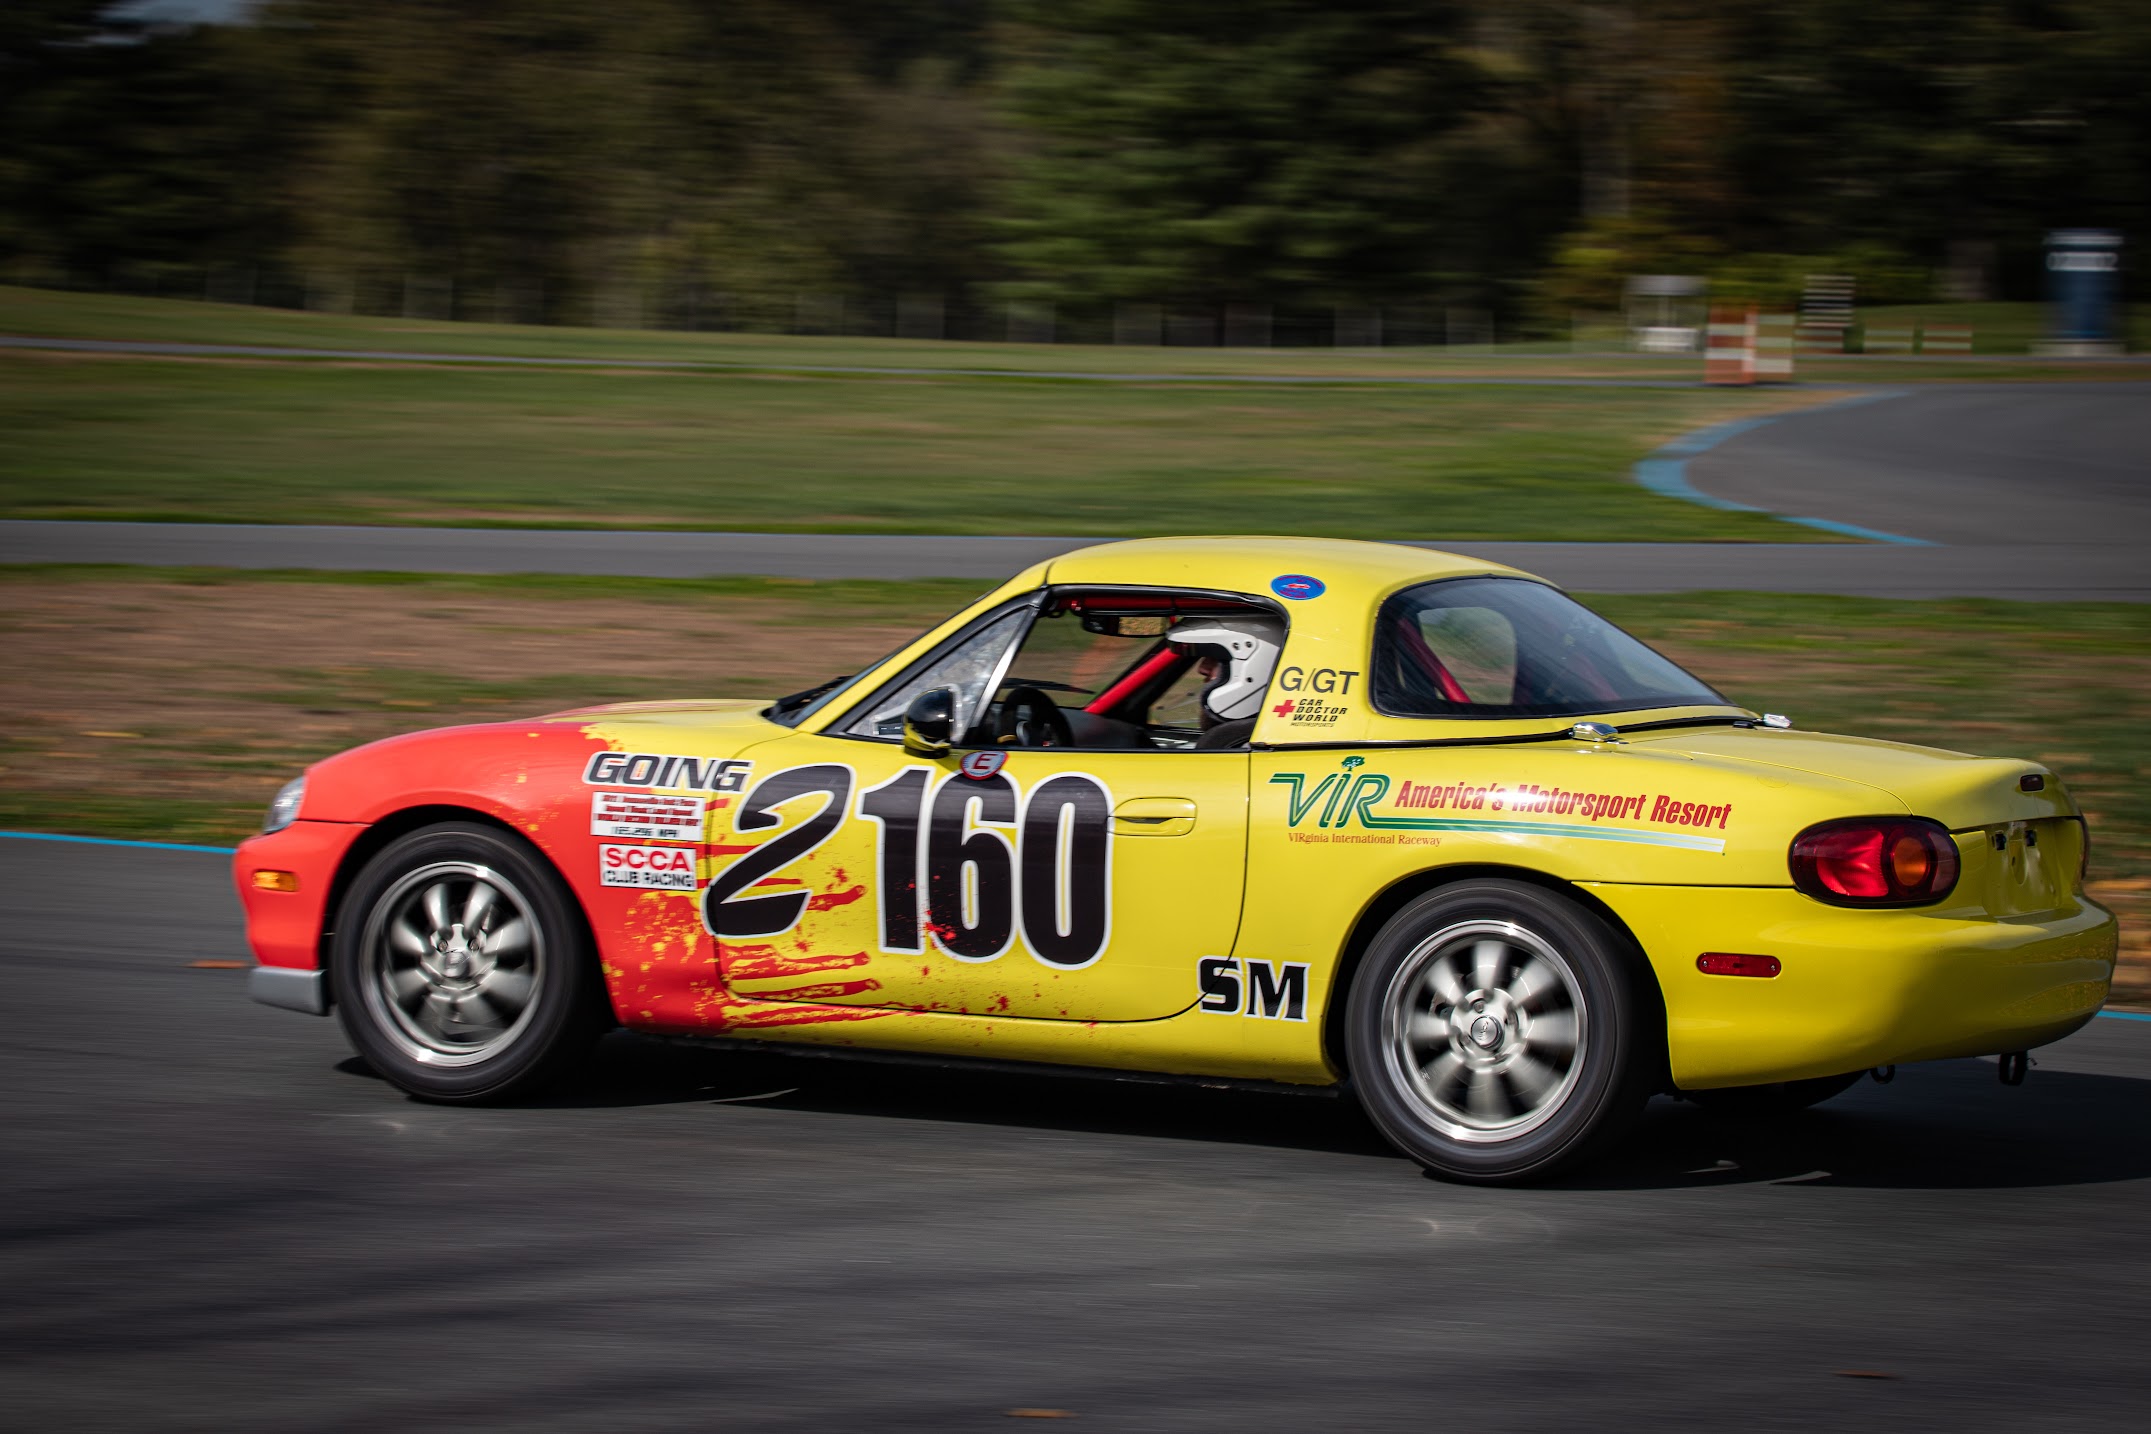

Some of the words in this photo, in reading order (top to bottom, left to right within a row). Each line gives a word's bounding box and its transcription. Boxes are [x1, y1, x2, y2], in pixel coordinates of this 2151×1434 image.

[1280, 666, 1359, 694] G/GT
[1296, 706, 1347, 714] DOCTOR
[1299, 698, 1323, 706] CAR
[1293, 714, 1338, 722] WORLD
[972, 753, 998, 769] E
[586, 751, 752, 792] GOING
[1394, 780, 1508, 811] America's
[1512, 784, 1647, 822] Motorsport
[1650, 794, 1732, 830] Resort
[1331, 832, 1395, 845] International
[1398, 834, 1442, 847] Raceway
[605, 847, 690, 872] SCCA
[603, 870, 638, 884] CLUB
[642, 871, 695, 888] RACING
[1198, 957, 1309, 1021] SM
